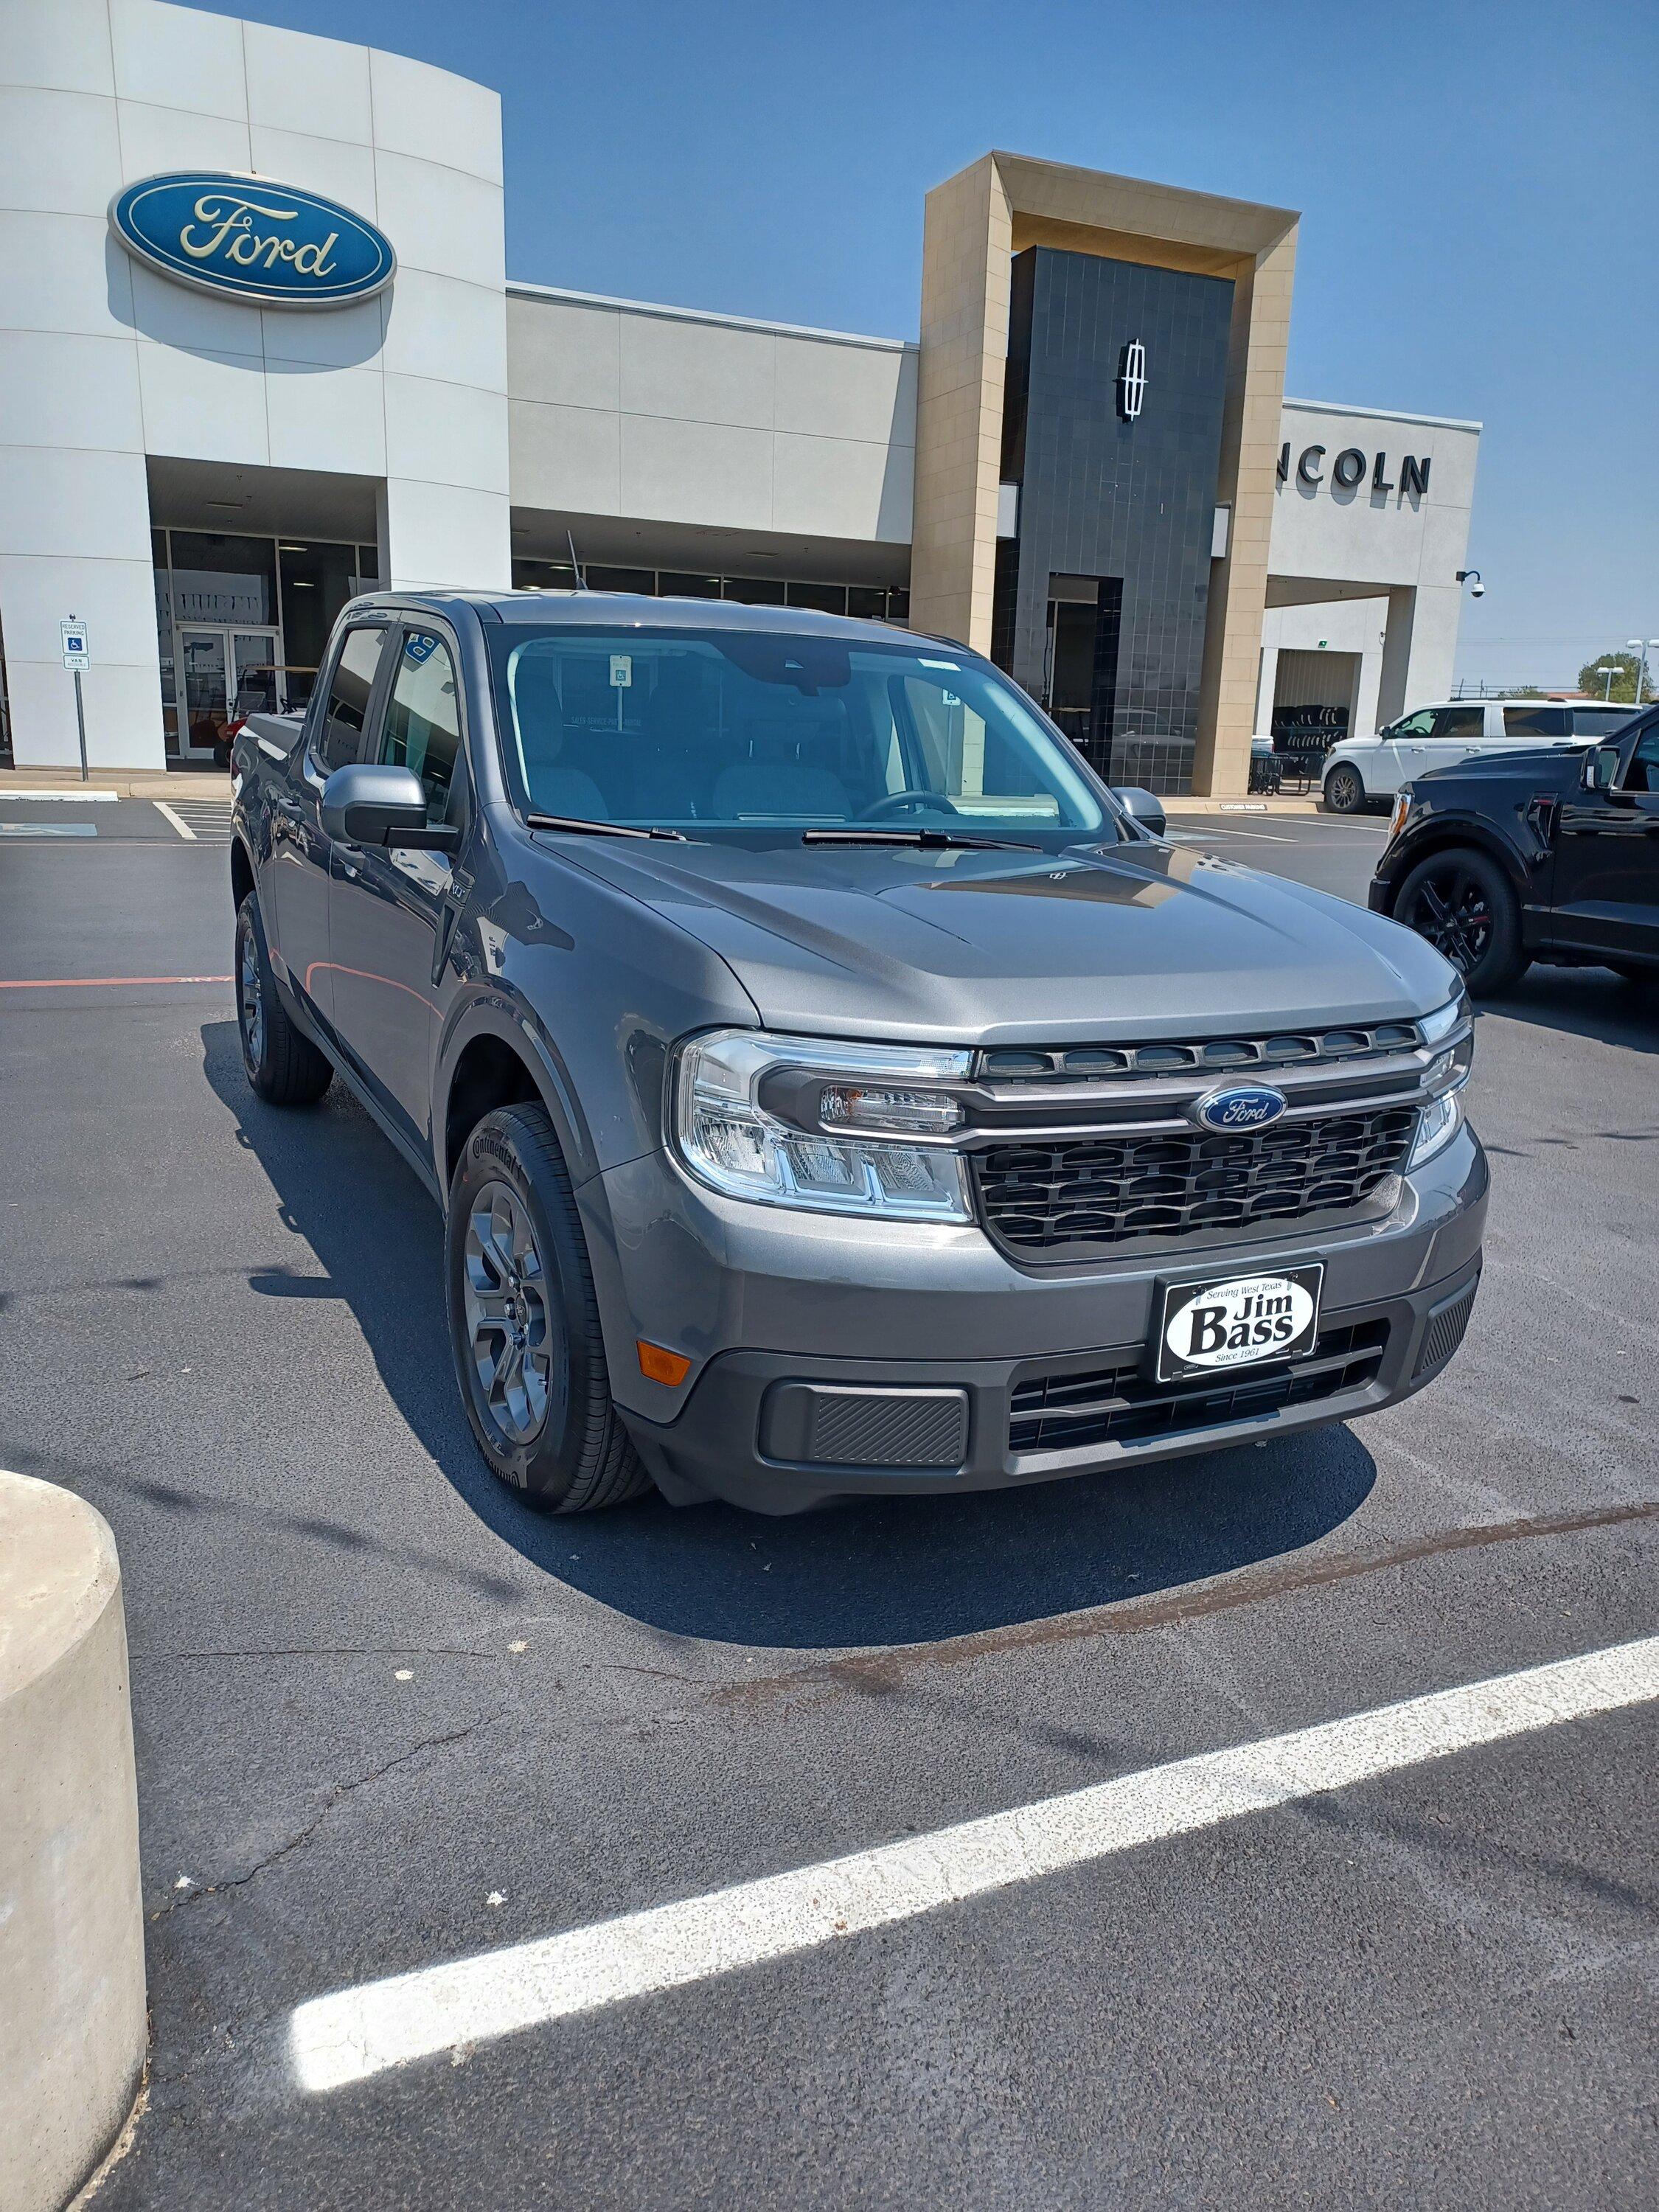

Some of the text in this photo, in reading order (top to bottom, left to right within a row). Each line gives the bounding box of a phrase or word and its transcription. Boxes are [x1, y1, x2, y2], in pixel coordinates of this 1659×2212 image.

[180, 195, 340, 277] Ford
[1277, 442, 1431, 494] NCOLN
[1222, 1097, 1270, 1123] Ford
[472, 1135, 517, 1174] Continental
[1206, 1281, 1282, 1300] Serving West Texas
[1233, 1293, 1293, 1321] Jim
[1186, 1305, 1293, 1357] Bass
[1215, 1348, 1259, 1363] Since 1961
